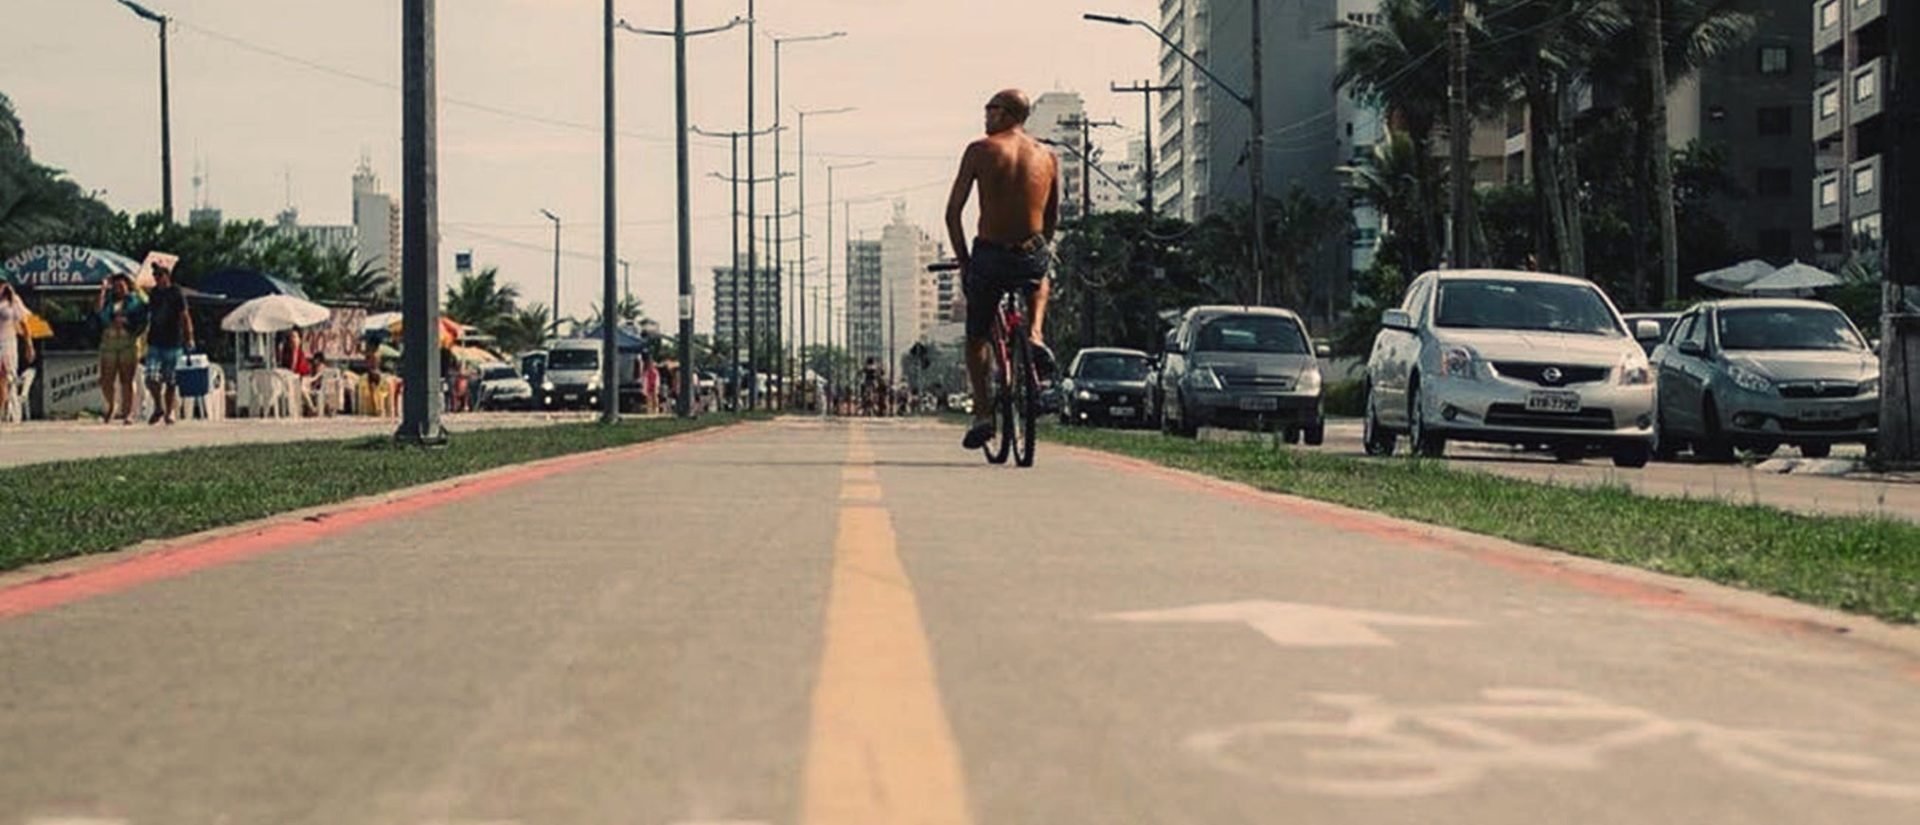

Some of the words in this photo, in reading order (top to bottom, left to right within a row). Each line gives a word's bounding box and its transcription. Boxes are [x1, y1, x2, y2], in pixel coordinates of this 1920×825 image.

[4, 243, 97, 272] QUIOSQUE
[47, 259, 69, 270] DO
[16, 271, 82, 284] VIEIRA
